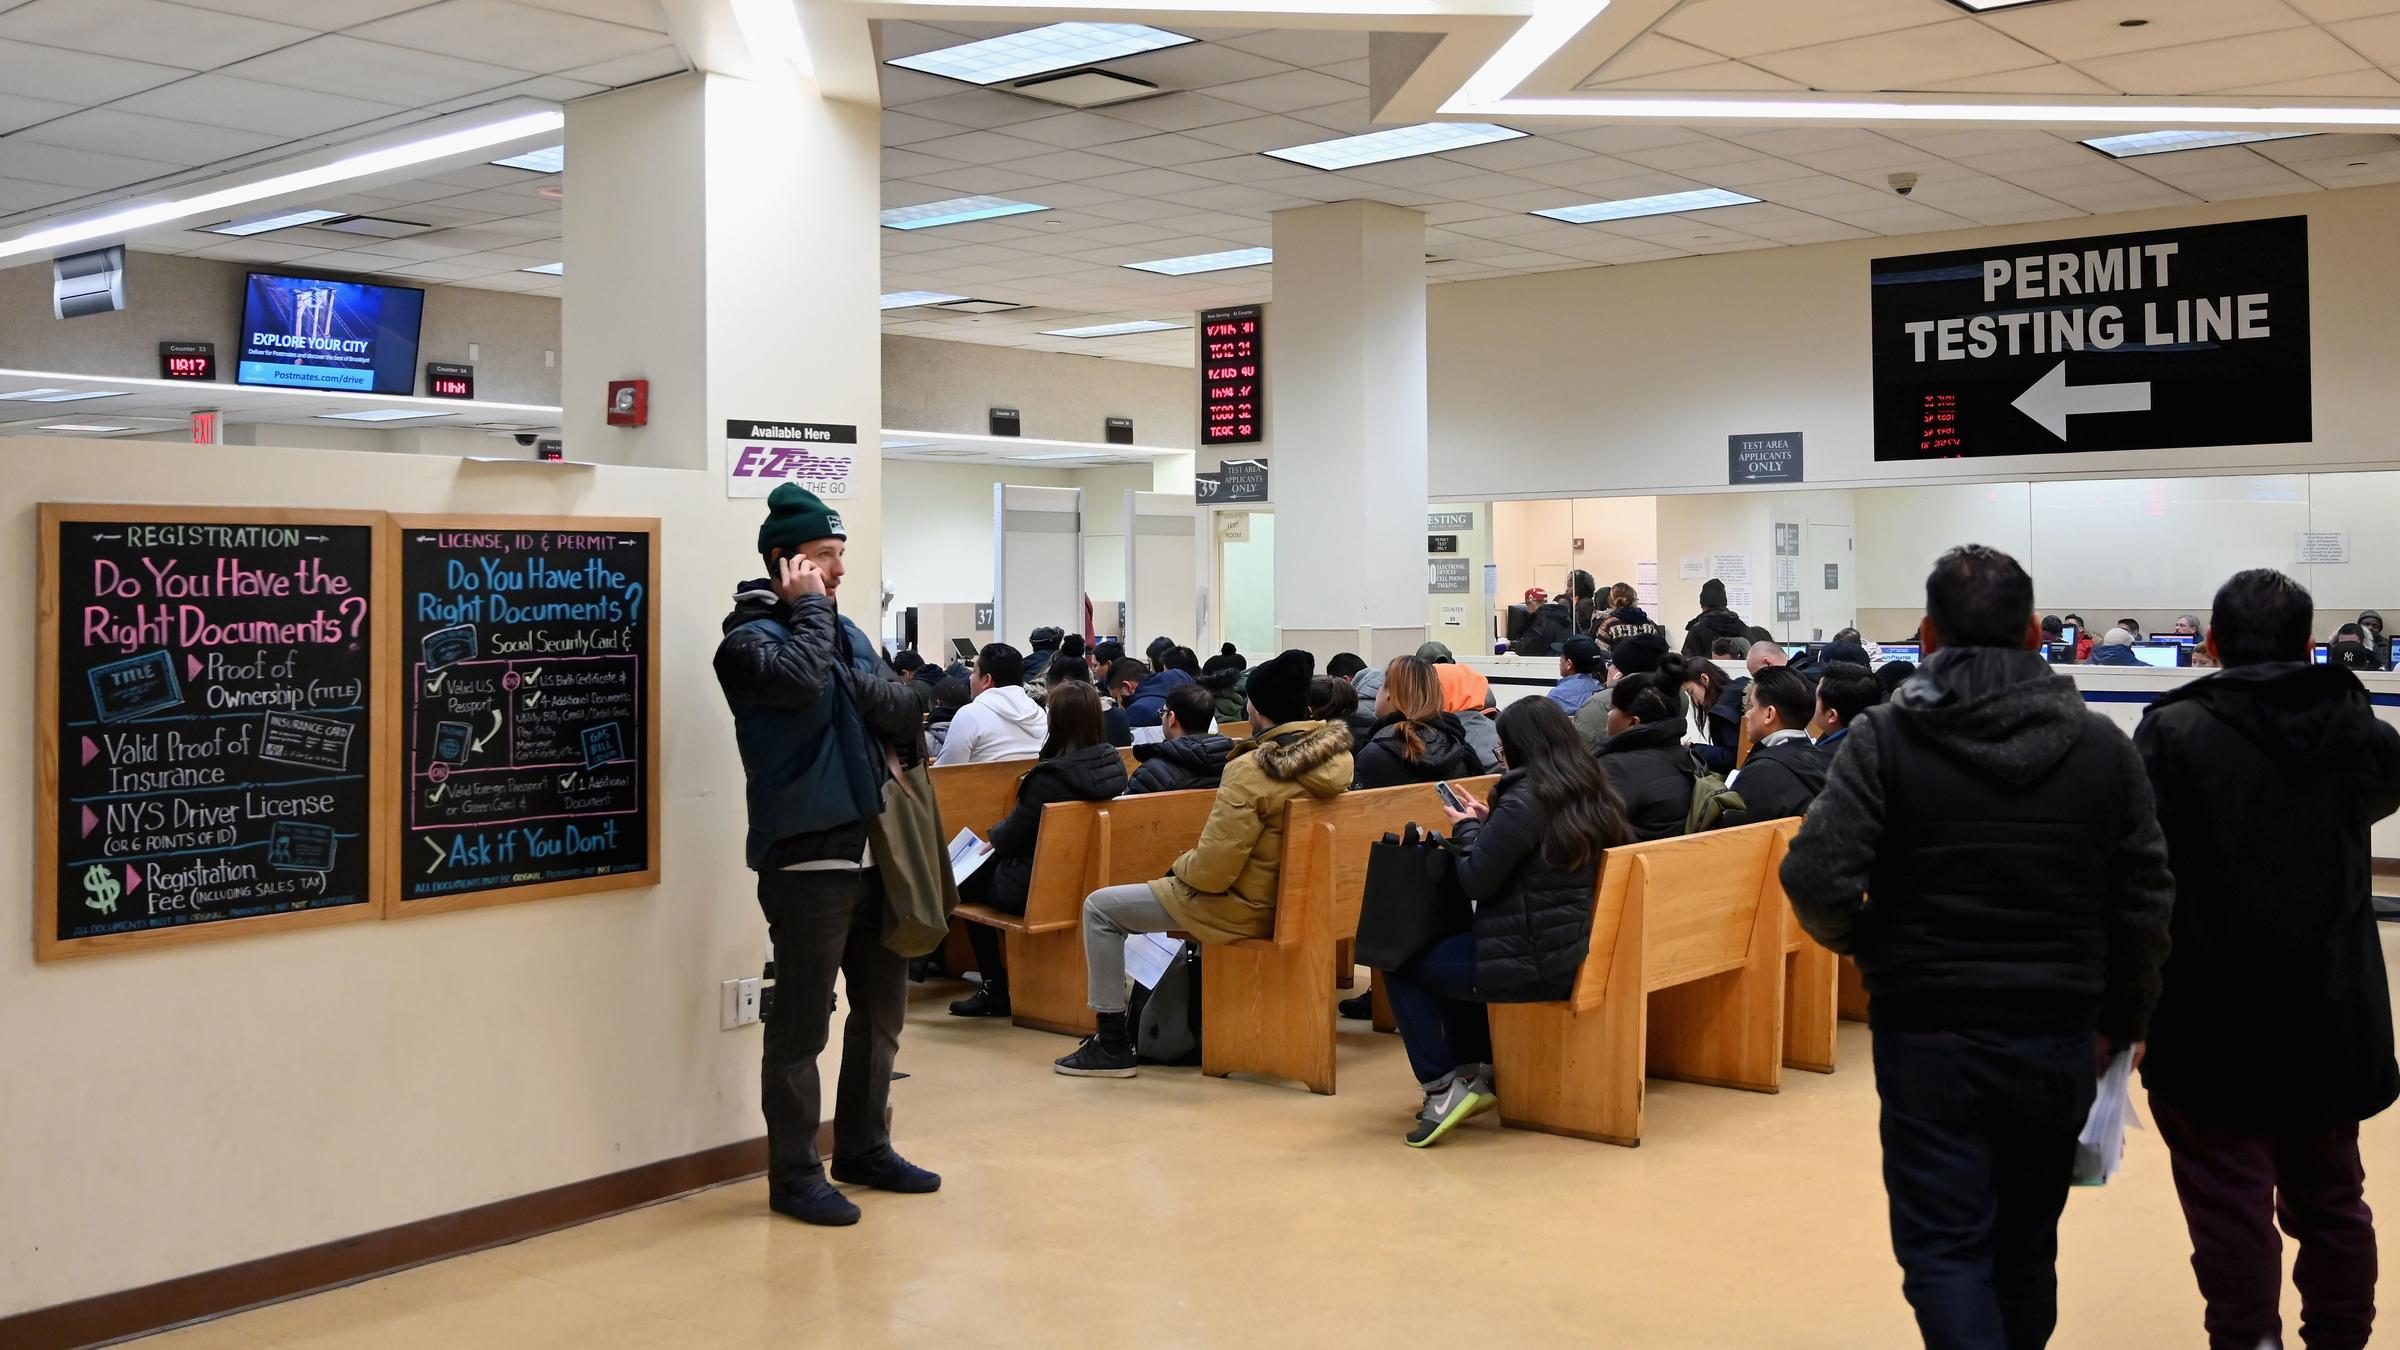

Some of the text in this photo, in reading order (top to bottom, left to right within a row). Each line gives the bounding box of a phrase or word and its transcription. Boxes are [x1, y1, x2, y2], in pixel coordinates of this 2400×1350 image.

[1983, 243, 2179, 302] PERMIT
[1905, 293, 2271, 363] TESTING LINE
[253, 332, 369, 353] EXPLORE YOUR CITY
[274, 370, 364, 385] Postmates.com/drive
[193, 414, 216, 445] EXIT
[751, 425, 831, 440] Available Here
[1743, 440, 1789, 450] TEST AREA
[1739, 451, 1792, 462] APPLICANTS
[1748, 460, 1784, 473] ONLY
[1225, 475, 1263, 484] APPLICANTS
[1228, 465, 1261, 474] TEST AREA
[807, 482, 846, 494] THE GO
[1199, 480, 1218, 497] 39
[1231, 484, 1257, 493] ONLY
[1428, 514, 1466, 525] ESTING
[127, 526, 300, 548] REGISTRATION
[438, 533, 617, 553] LICENSE, ID & PERMIT
[94, 557, 352, 599] Do You Have the
[448, 557, 627, 591] Do You Have the
[418, 582, 644, 628] Right Documents?
[83, 597, 368, 653] Right Documents?
[978, 609, 993, 625] 37
[491, 630, 533, 654] Social
[536, 630, 590, 655] Security
[590, 628, 617, 650] Card
[111, 664, 156, 686] TITLE
[207, 650, 298, 681] Proof of
[207, 677, 362, 710] Ownership (TITLE)
[446, 679, 474, 694] Valid
[448, 696, 494, 717] Passport
[324, 726, 348, 737] CARD
[591, 729, 610, 742] GAS
[104, 724, 252, 765] Valid Proof of
[591, 740, 613, 753] BILL
[108, 767, 225, 794] Insurance
[446, 783, 472, 799] Valid
[508, 776, 549, 793] Passport
[588, 775, 630, 790] Additional
[105, 791, 335, 835] NYS Driver License
[462, 799, 493, 813] Green
[104, 837, 129, 856] (OR
[146, 831, 195, 851] POINTS
[197, 831, 214, 847] OF
[216, 825, 238, 846] ID)
[448, 819, 619, 868] Ask if You Don't
[146, 858, 257, 893] Registration
[83, 864, 121, 915] $
[147, 891, 187, 914] Fee
[255, 880, 296, 896] SALES
